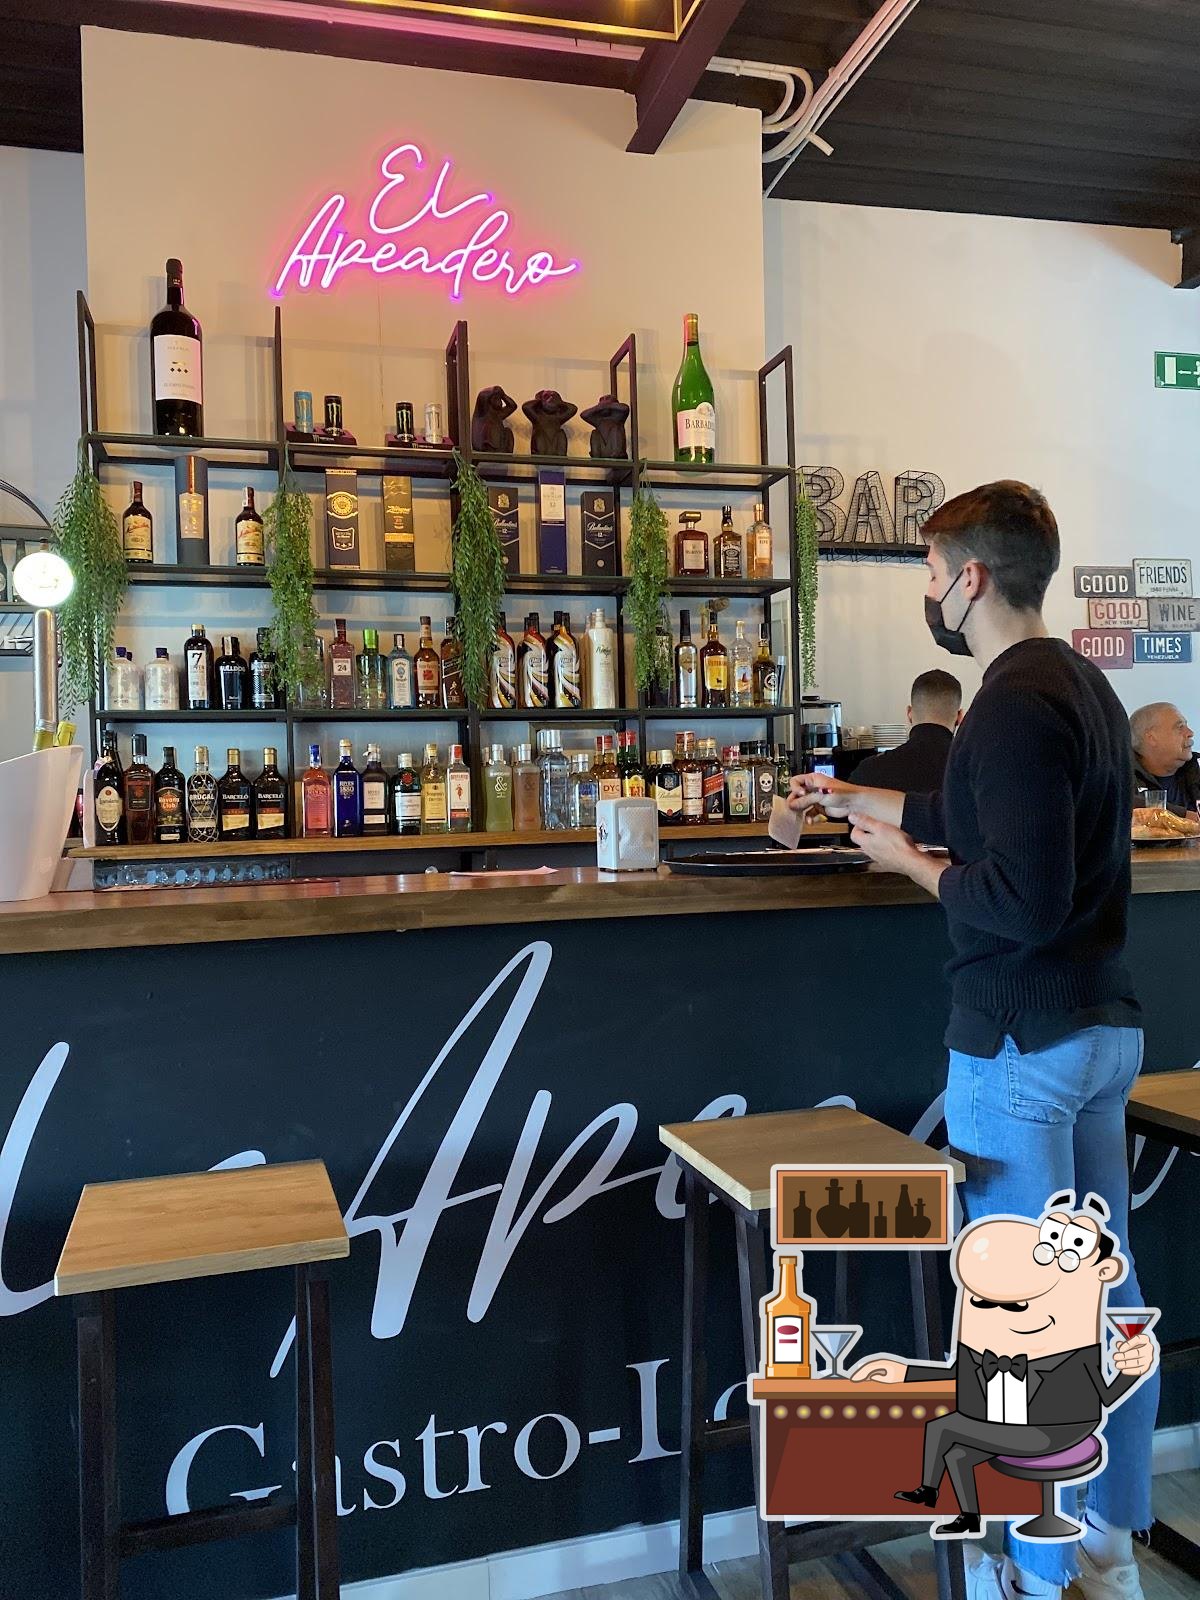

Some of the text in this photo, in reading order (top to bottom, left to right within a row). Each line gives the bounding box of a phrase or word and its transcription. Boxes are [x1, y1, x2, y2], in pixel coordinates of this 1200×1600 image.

[368, 143, 494, 235] El
[271, 194, 581, 299] Apeadero
[796, 466, 945, 545] BAR
[1080, 566, 1188, 593] GOOD FRIENDS
[1094, 602, 1197, 622] GOOD WINE
[1080, 636, 1182, 658] GOOD TIMES
[191, 652, 203, 670] 7
[189, 793, 215, 801] BRUGAL
